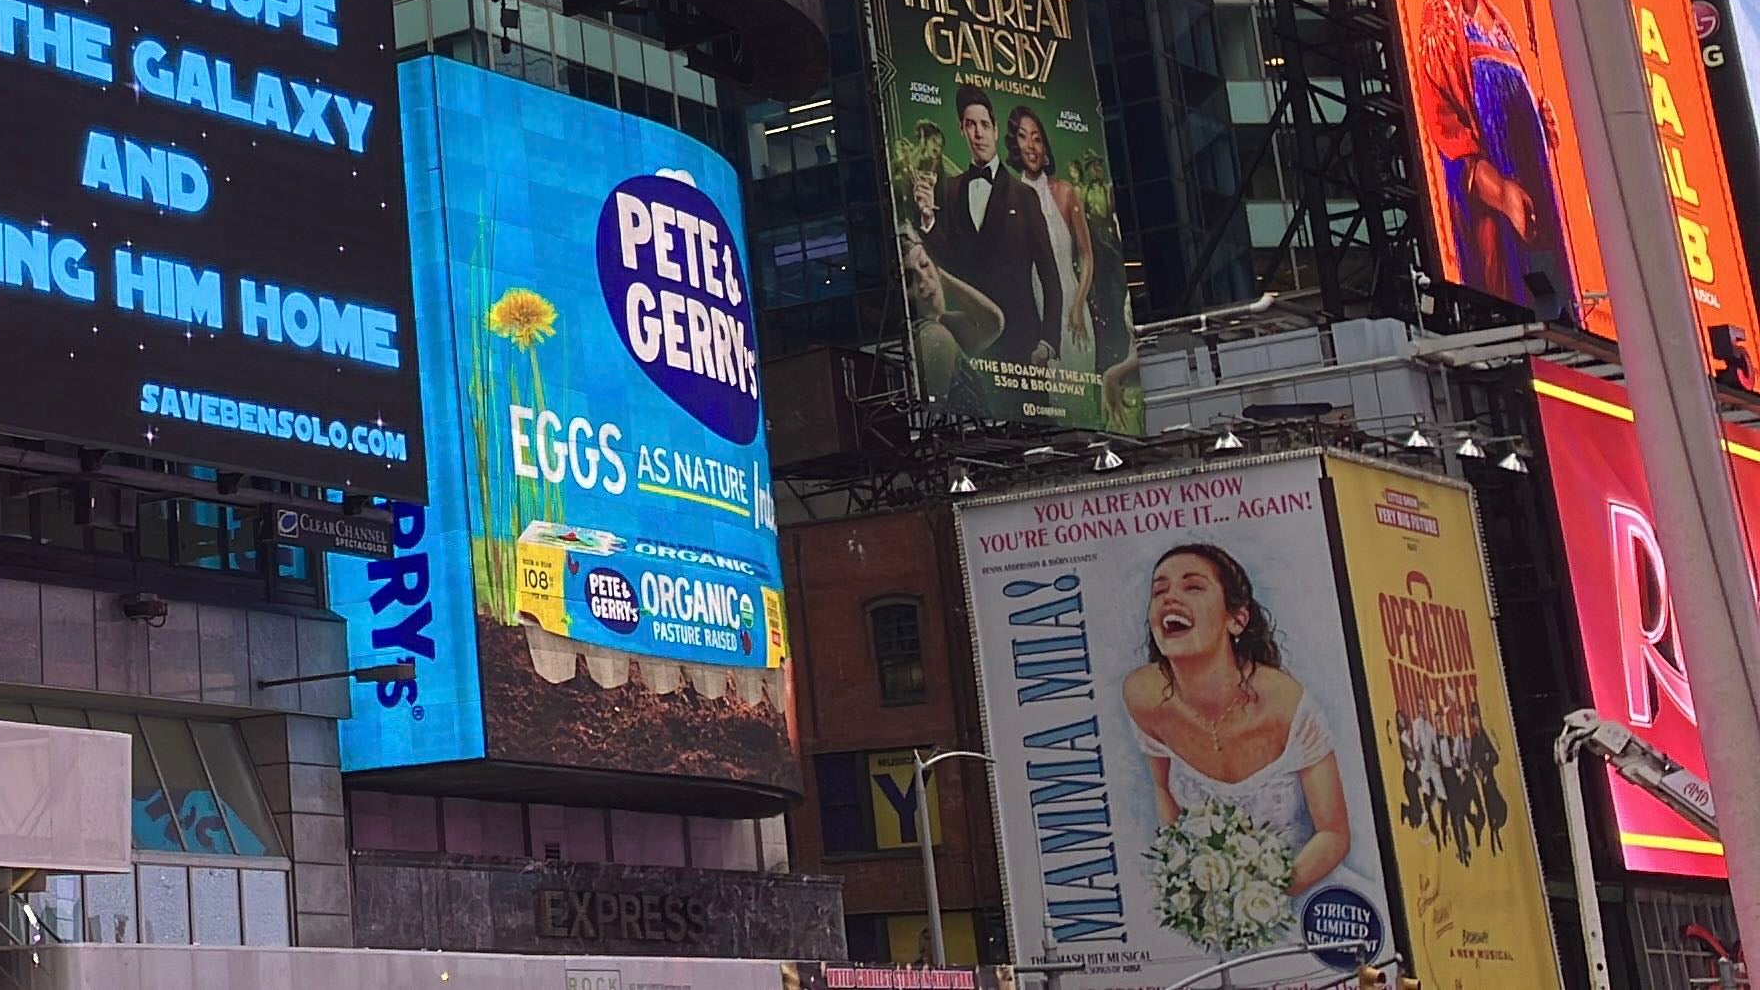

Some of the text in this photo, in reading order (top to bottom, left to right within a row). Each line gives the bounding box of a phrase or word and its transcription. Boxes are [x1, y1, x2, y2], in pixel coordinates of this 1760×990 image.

[924, 16, 1058, 83] GATSBY
[133, 40, 373, 153] GALAXY
[954, 72, 1046, 100] A NEW MUSICAL
[82, 131, 209, 212] AND
[616, 192, 724, 299] PETE
[114, 248, 223, 329] HIM
[239, 279, 399, 368] HOME
[627, 282, 758, 400] GERRY'S
[1000, 361, 1057, 379] BROADWAY
[1059, 368, 1104, 386] THEATRE
[1021, 378, 1030, 391] &
[1031, 379, 1085, 396] BROADWAY
[141, 384, 407, 462] SAVEBENSOLO.COM
[509, 405, 627, 495] EGGS
[638, 444, 670, 485] AS
[674, 451, 748, 505] NATURE
[979, 491, 1313, 555] YOU'RE GONNA LOVE IT... AGAIN!
[1034, 476, 1243, 525] YOU ALREADY KNOW
[335, 536, 389, 554] SPECTACOLOR
[634, 543, 755, 576] ORGANIC
[589, 573, 620, 598] PETE
[591, 596, 639, 622] GERRY'S
[640, 571, 741, 630] ORGANIC
[653, 621, 738, 652] PASTURE RAISED
[1378, 591, 1475, 675] OPERATION
[1003, 573, 1127, 944] MAMMA MIA!
[543, 889, 708, 943] EXPRESS
[1313, 903, 1371, 923] STRICTLY
[1316, 918, 1369, 939] LIMITED
[1107, 950, 1152, 964] MUSICAL
